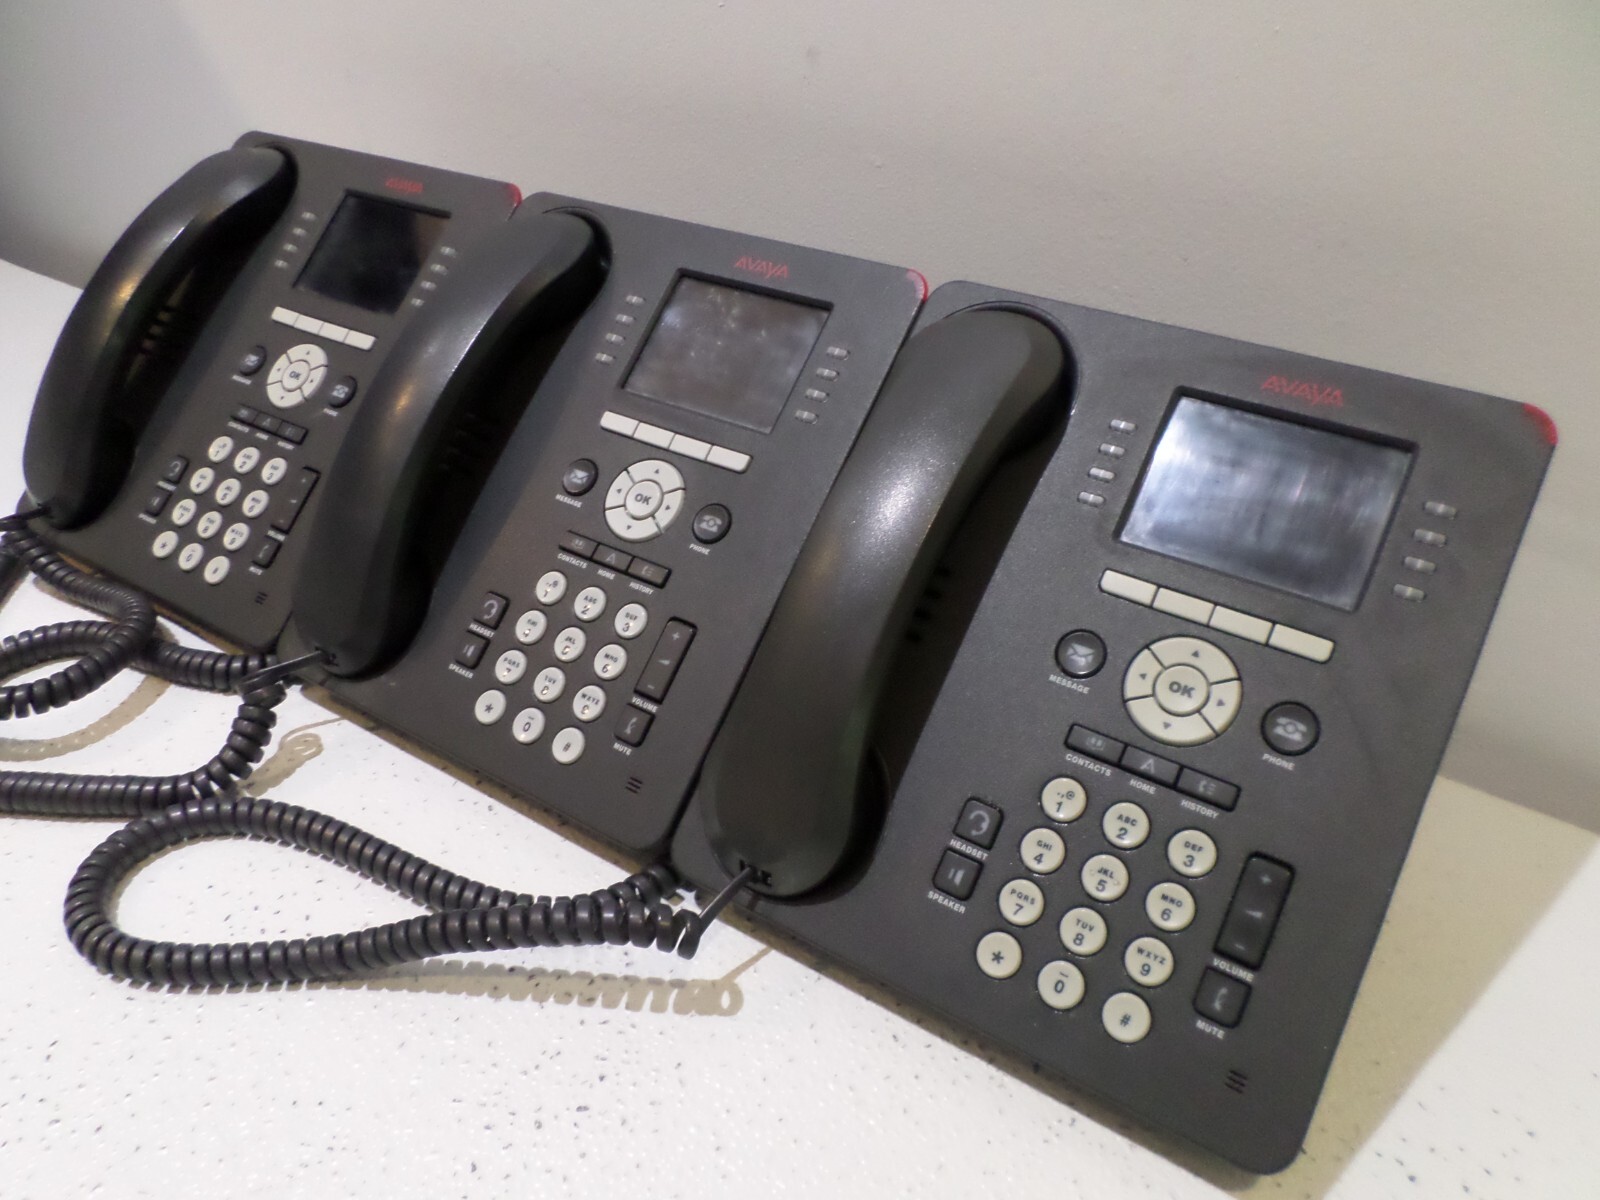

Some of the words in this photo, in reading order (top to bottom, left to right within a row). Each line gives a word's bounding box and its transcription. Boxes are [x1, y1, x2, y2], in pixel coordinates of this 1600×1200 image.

[735, 256, 788, 279] AVAYA
[1262, 375, 1344, 407] AVAYA
[555, 493, 583, 508] MESSAGE
[634, 493, 652, 506] OK
[689, 543, 711, 556] PHONE
[557, 552, 588, 569] CONTACTS
[597, 569, 616, 580] HOME
[628, 582, 655, 595] HISTORY
[468, 622, 495, 639] HEADSET
[448, 663, 474, 680] SPEAKER
[601, 663, 611, 674] 6
[1048, 673, 1090, 695] MESSAGE
[1168, 681, 1195, 699] OK
[632, 696, 660, 713] VOLUME
[522, 721, 532, 733] 0
[612, 742, 633, 756] MUTE
[1065, 753, 1112, 777] CONTACTS
[1262, 752, 1296, 772] PHONE
[1129, 778, 1157, 795] HOME
[1055, 801, 1064, 813] 1
[1181, 799, 1219, 820] HISTORY
[1116, 813, 1139, 827] ABC
[1116, 827, 1128, 840] 2
[950, 838, 989, 861] HEADSET
[1036, 839, 1053, 851] GHI
[1183, 840, 1205, 854] DEF
[1033, 853, 1044, 865] 4
[1183, 855, 1196, 868] 3
[1097, 866, 1115, 879] JKL
[1095, 879, 1108, 893] 5
[927, 890, 966, 915] SPEAKER
[1010, 888, 1036, 905] PQRS
[1160, 893, 1183, 908] MNO
[1013, 903, 1024, 915] 7
[1160, 908, 1173, 922] 6
[1075, 918, 1096, 933] TUV
[1073, 933, 1085, 946] 8
[1136, 947, 1167, 965] WXYZ
[1140, 963, 1152, 977] 9
[1212, 957, 1255, 983] VOLUME
[1053, 980, 1065, 994] 0
[1195, 1019, 1226, 1040] MUTE
